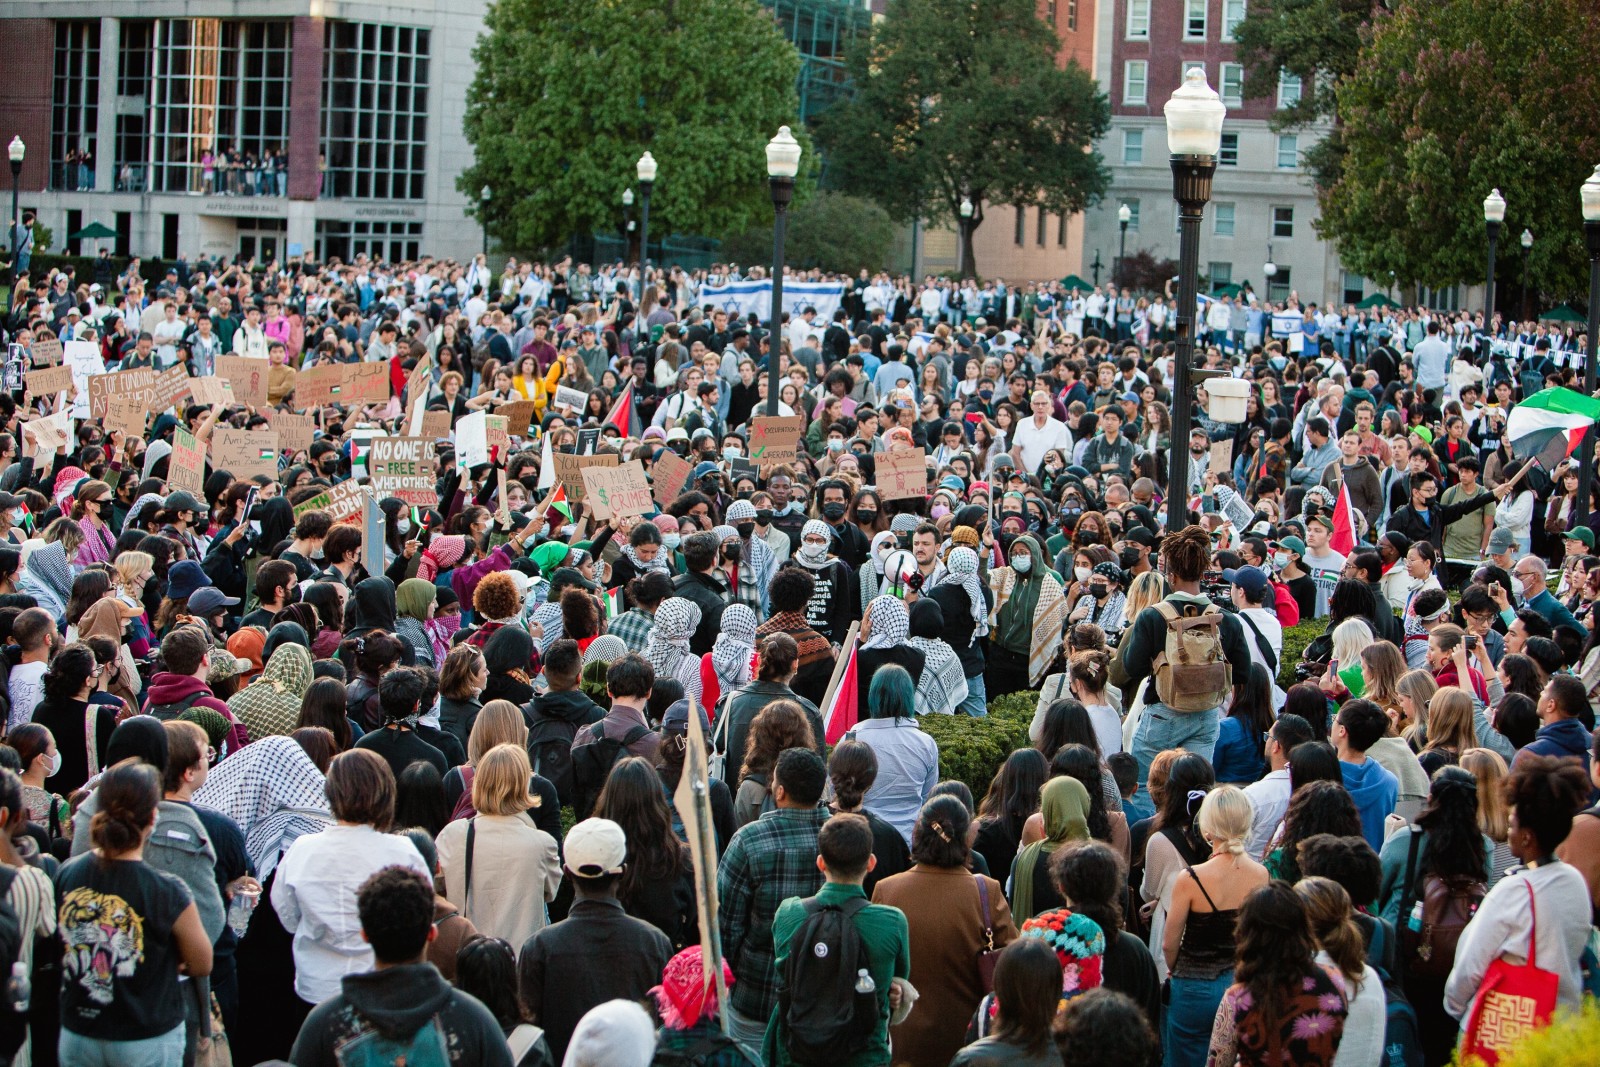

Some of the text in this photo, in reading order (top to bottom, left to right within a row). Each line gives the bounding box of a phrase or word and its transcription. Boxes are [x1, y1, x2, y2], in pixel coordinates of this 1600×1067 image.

[402, 208, 415, 216] HALL
[92, 375, 117, 396] STOP
[120, 371, 154, 391] FUNDING
[93, 388, 154, 415] APRTHEID
[109, 402, 124, 418] FREE
[272, 415, 311, 427] PALESTINE
[765, 426, 797, 434] OCCUPATION
[176, 428, 195, 452] TRUTH
[372, 440, 435, 461] NO ONE IS
[762, 450, 795, 459] LIBERATION
[387, 461, 416, 475] FREE
[556, 456, 580, 470] YOU
[172, 462, 200, 491] OPPRESSED
[371, 475, 402, 490] WHEN
[587, 469, 635, 489] NO MORE
[329, 485, 347, 501] IS
[345, 478, 360, 494] ON
[394, 489, 438, 504] OPPRESSED
[611, 485, 625, 493] FOR
[906, 486, 926, 495] 1948
[610, 489, 653, 511] CRIMES
[806, 599, 826, 607] ppo&
